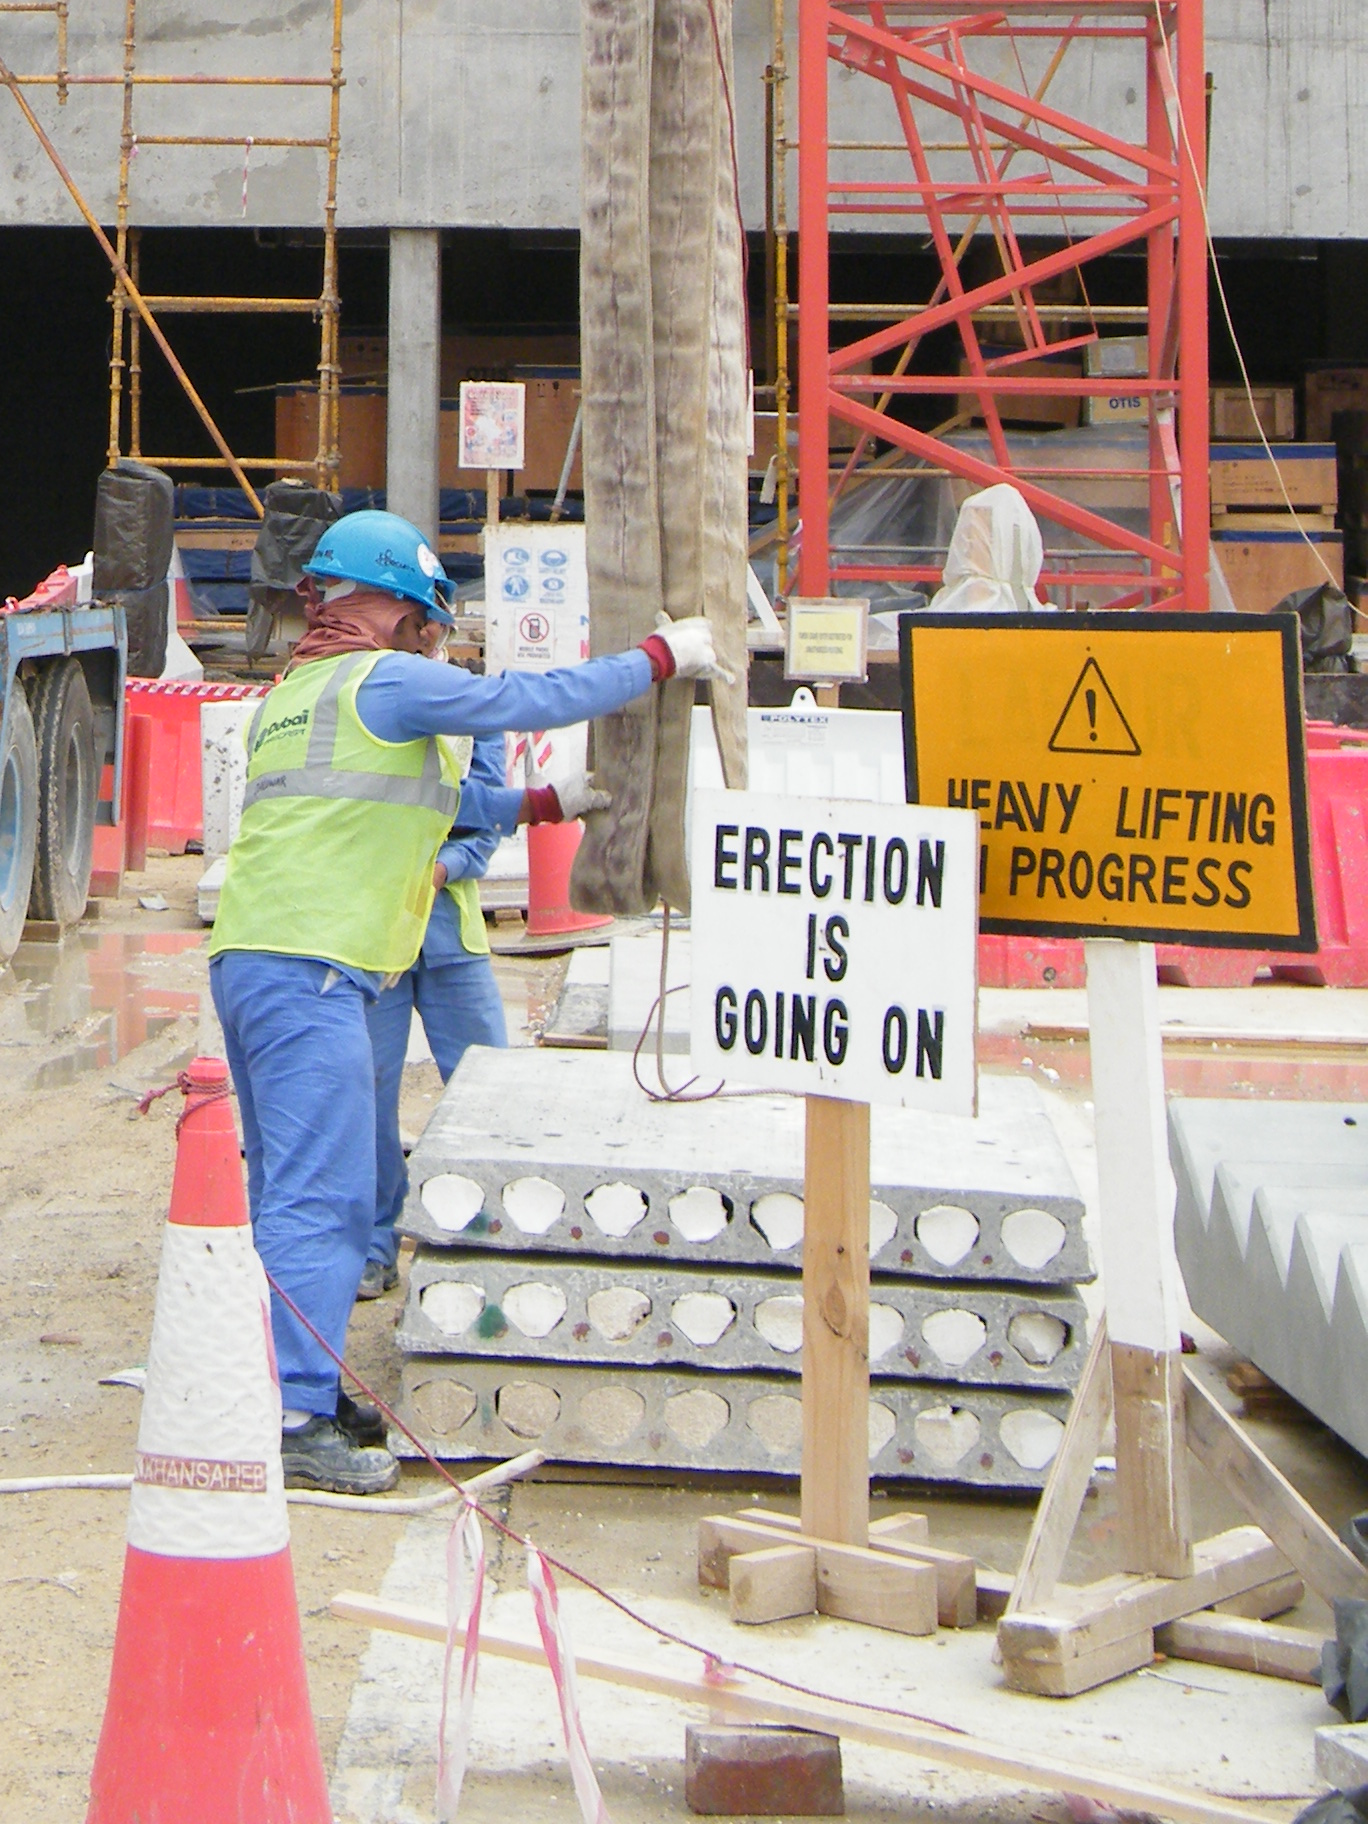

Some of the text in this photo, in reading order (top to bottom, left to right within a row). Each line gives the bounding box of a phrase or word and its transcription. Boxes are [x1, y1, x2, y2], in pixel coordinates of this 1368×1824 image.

[1109, 396, 1141, 409] OTIS
[947, 778, 1275, 845] HEAVY LIFTING
[714, 824, 945, 908] ERECTION
[1009, 846, 1254, 909] PROGRESS
[806, 913, 849, 982] IS
[715, 985, 944, 1080] GOING ON
